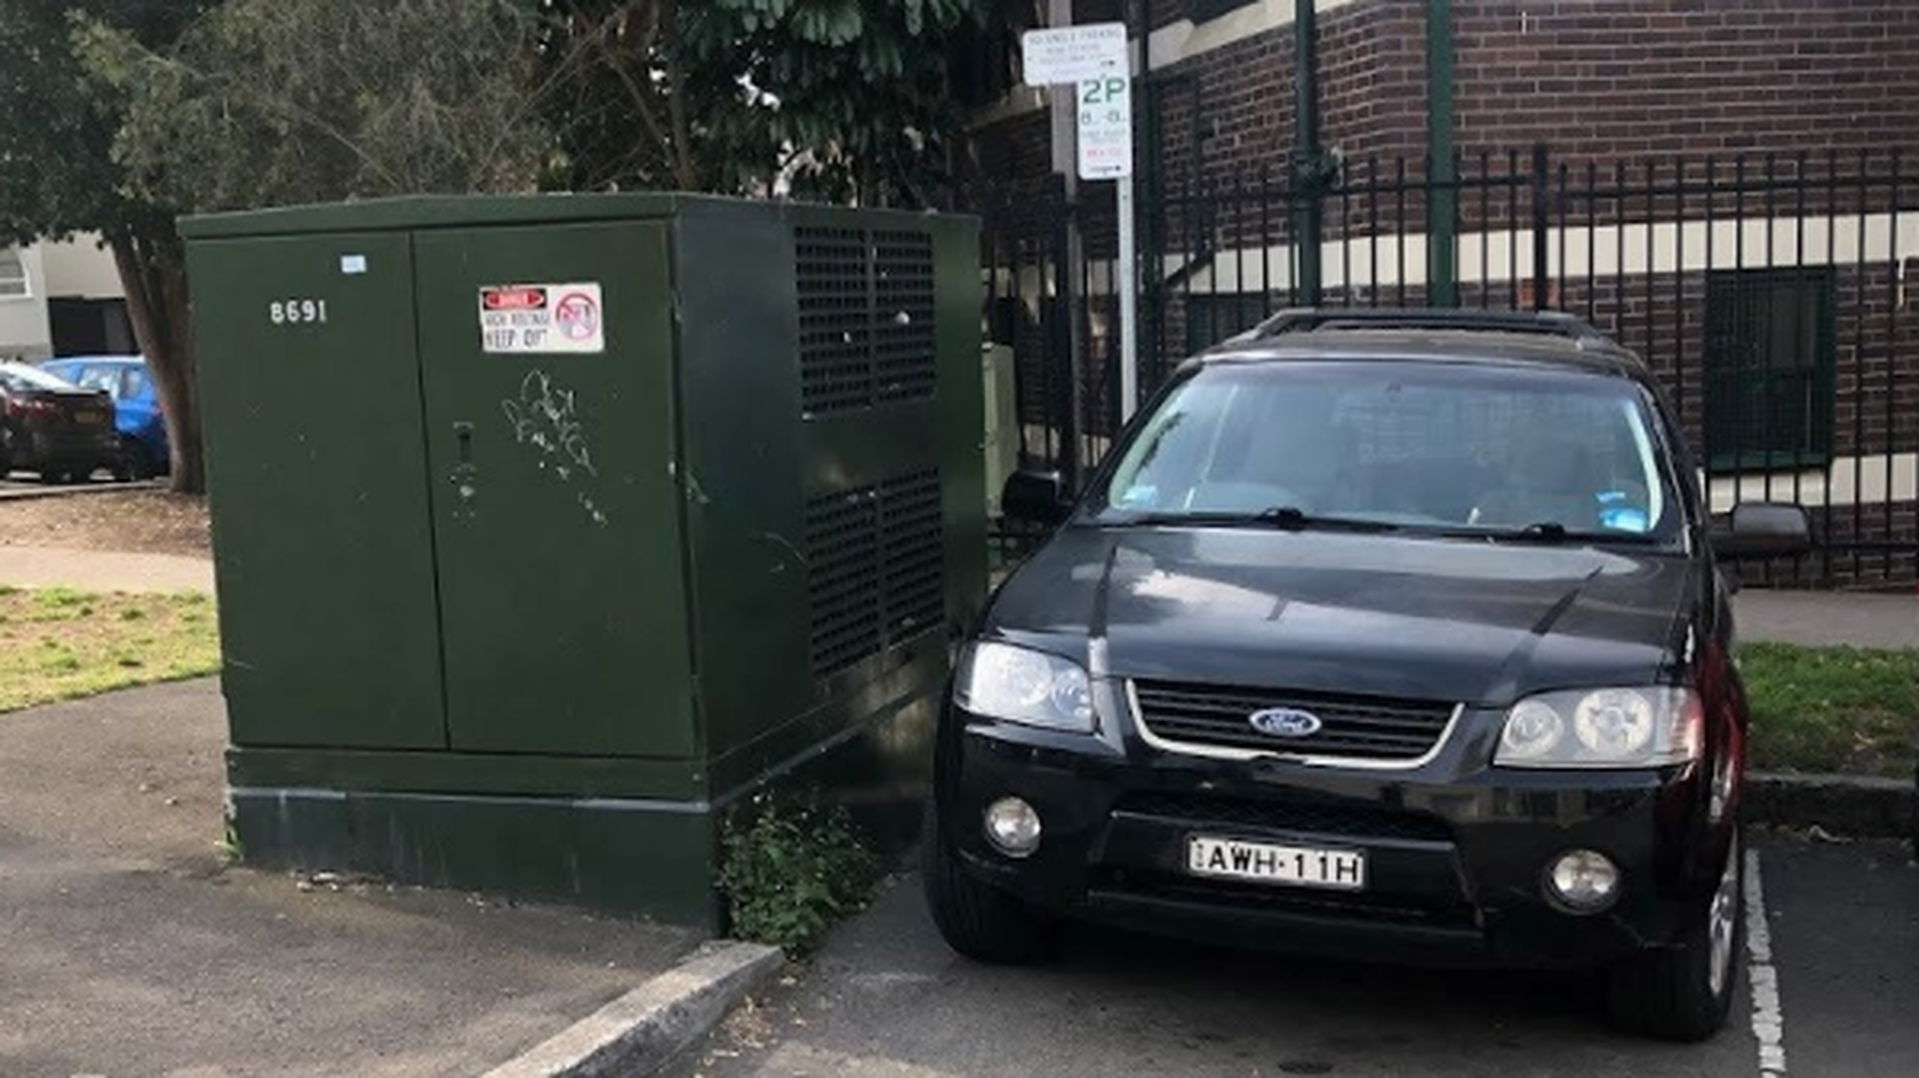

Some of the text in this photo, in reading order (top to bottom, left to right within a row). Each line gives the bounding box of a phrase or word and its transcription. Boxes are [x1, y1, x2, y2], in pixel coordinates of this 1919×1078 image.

[1083, 78, 1126, 104] 2P
[270, 300, 327, 324] 8691
[1256, 711, 1316, 735] Ford
